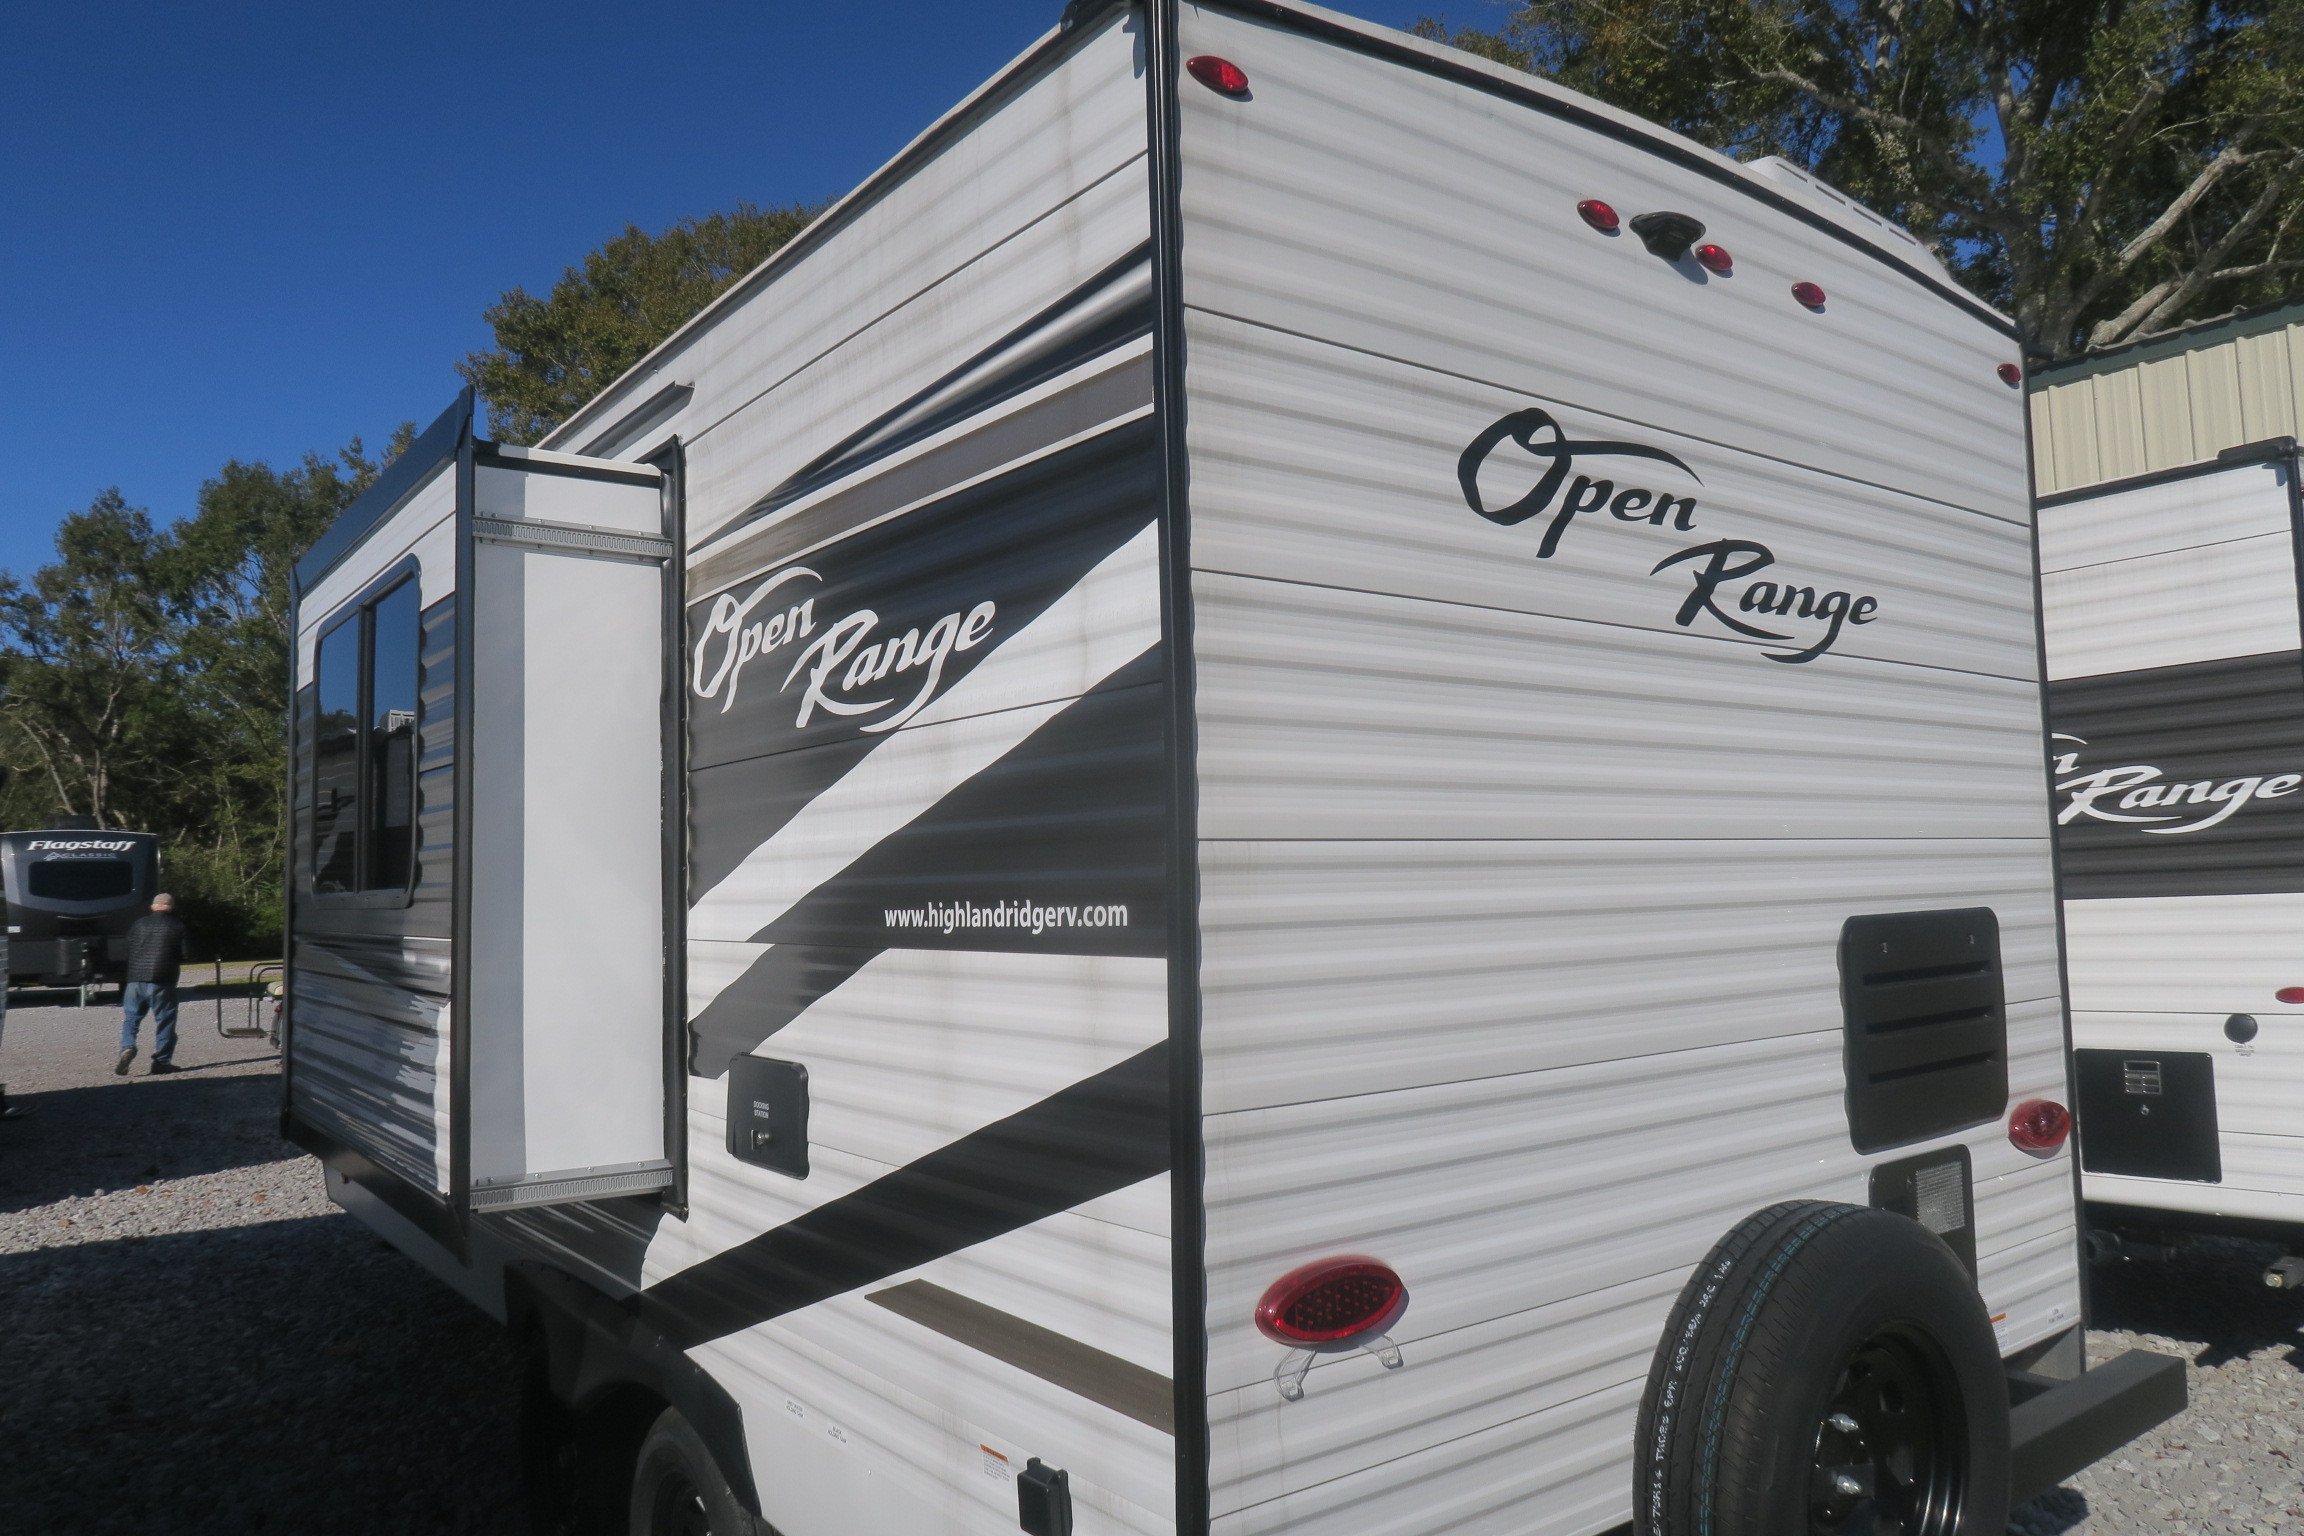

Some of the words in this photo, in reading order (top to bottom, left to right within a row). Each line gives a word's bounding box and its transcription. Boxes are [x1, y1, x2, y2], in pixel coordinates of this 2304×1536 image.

[1457, 407, 1705, 559] Open
[694, 566, 823, 714] Open
[1650, 538, 1879, 664] Range
[780, 600, 996, 733] Range
[26, 840, 136, 852] Flagstaff
[2055, 765, 2303, 834] Range
[884, 900, 1128, 934] www.highlandridgerv.com
